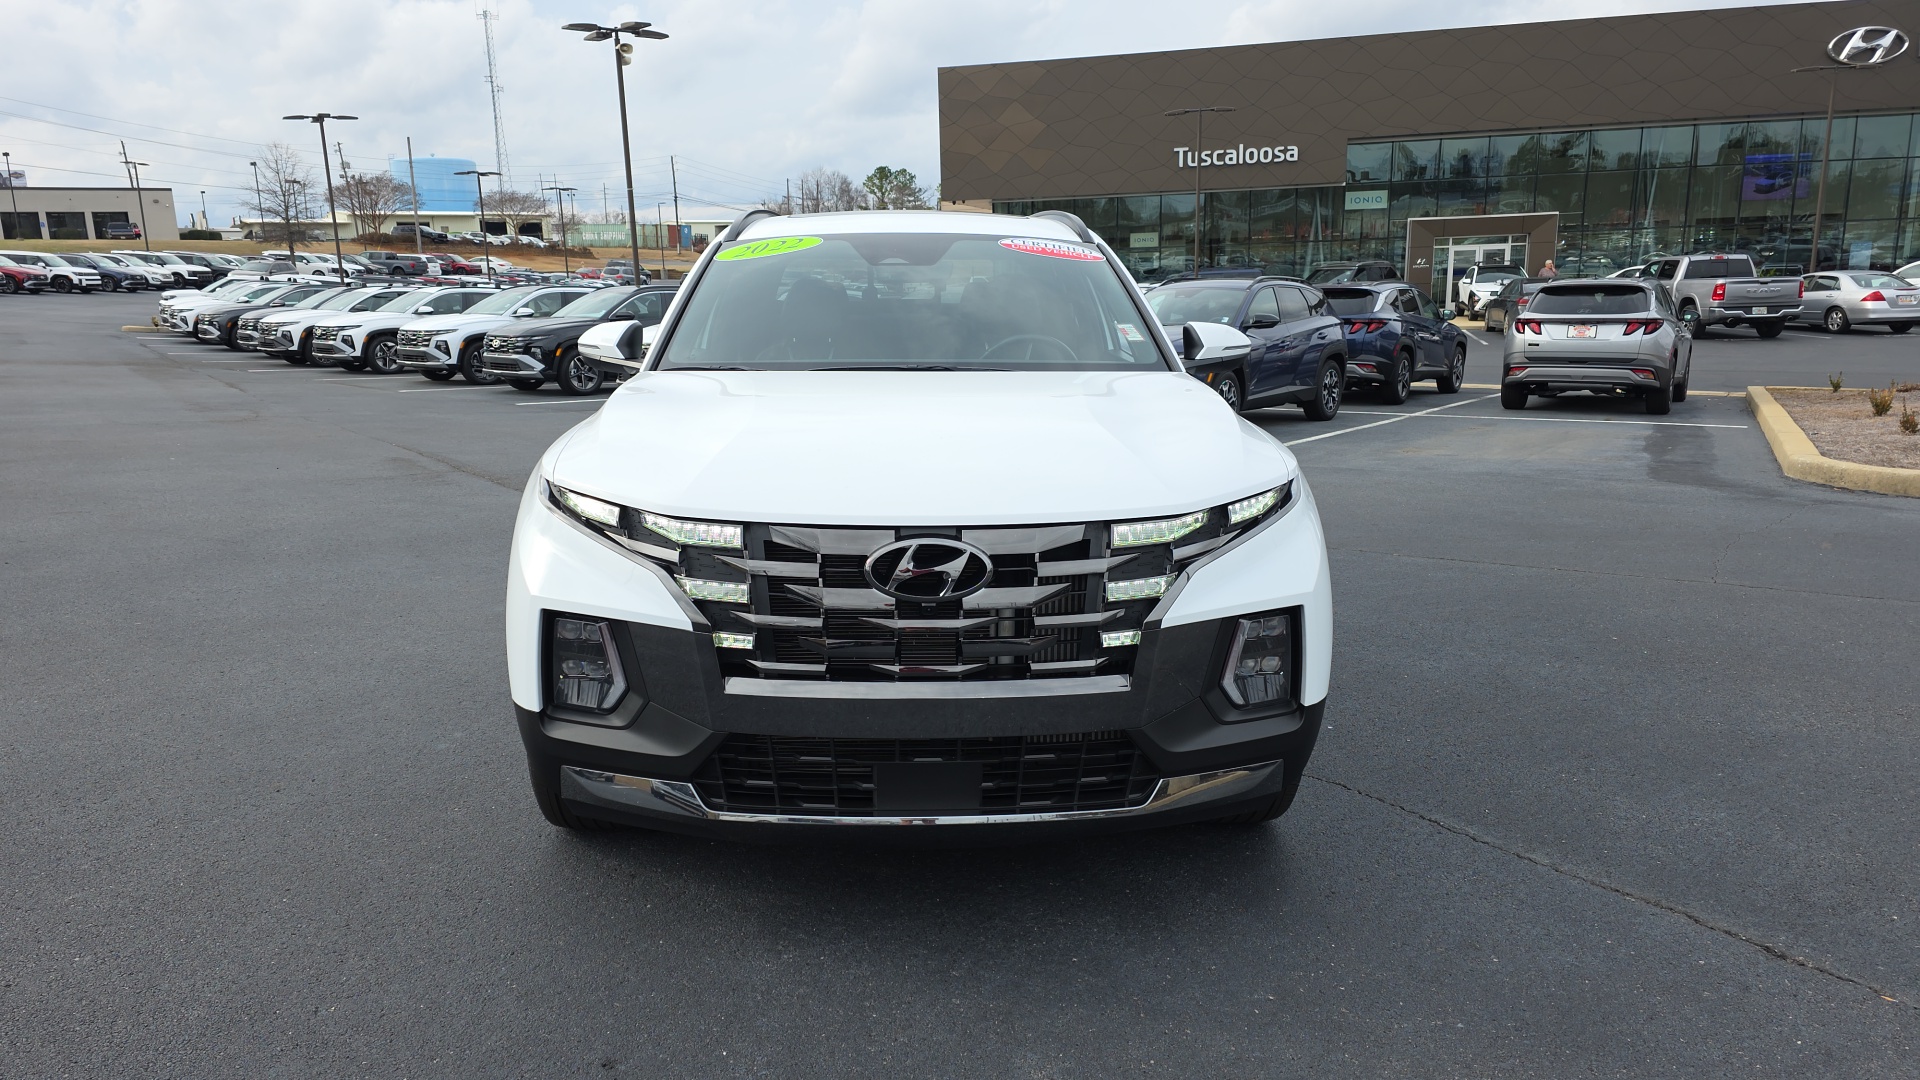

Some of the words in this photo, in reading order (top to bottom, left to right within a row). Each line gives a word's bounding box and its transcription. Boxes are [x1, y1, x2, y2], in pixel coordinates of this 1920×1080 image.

[1173, 143, 1299, 168] Tuscaloosa
[600, 231, 626, 240] SHIPPING
[733, 238, 804, 258] 2022
[1010, 238, 1093, 255] CERTIFIED
[1045, 248, 1095, 259] VEHICLE
